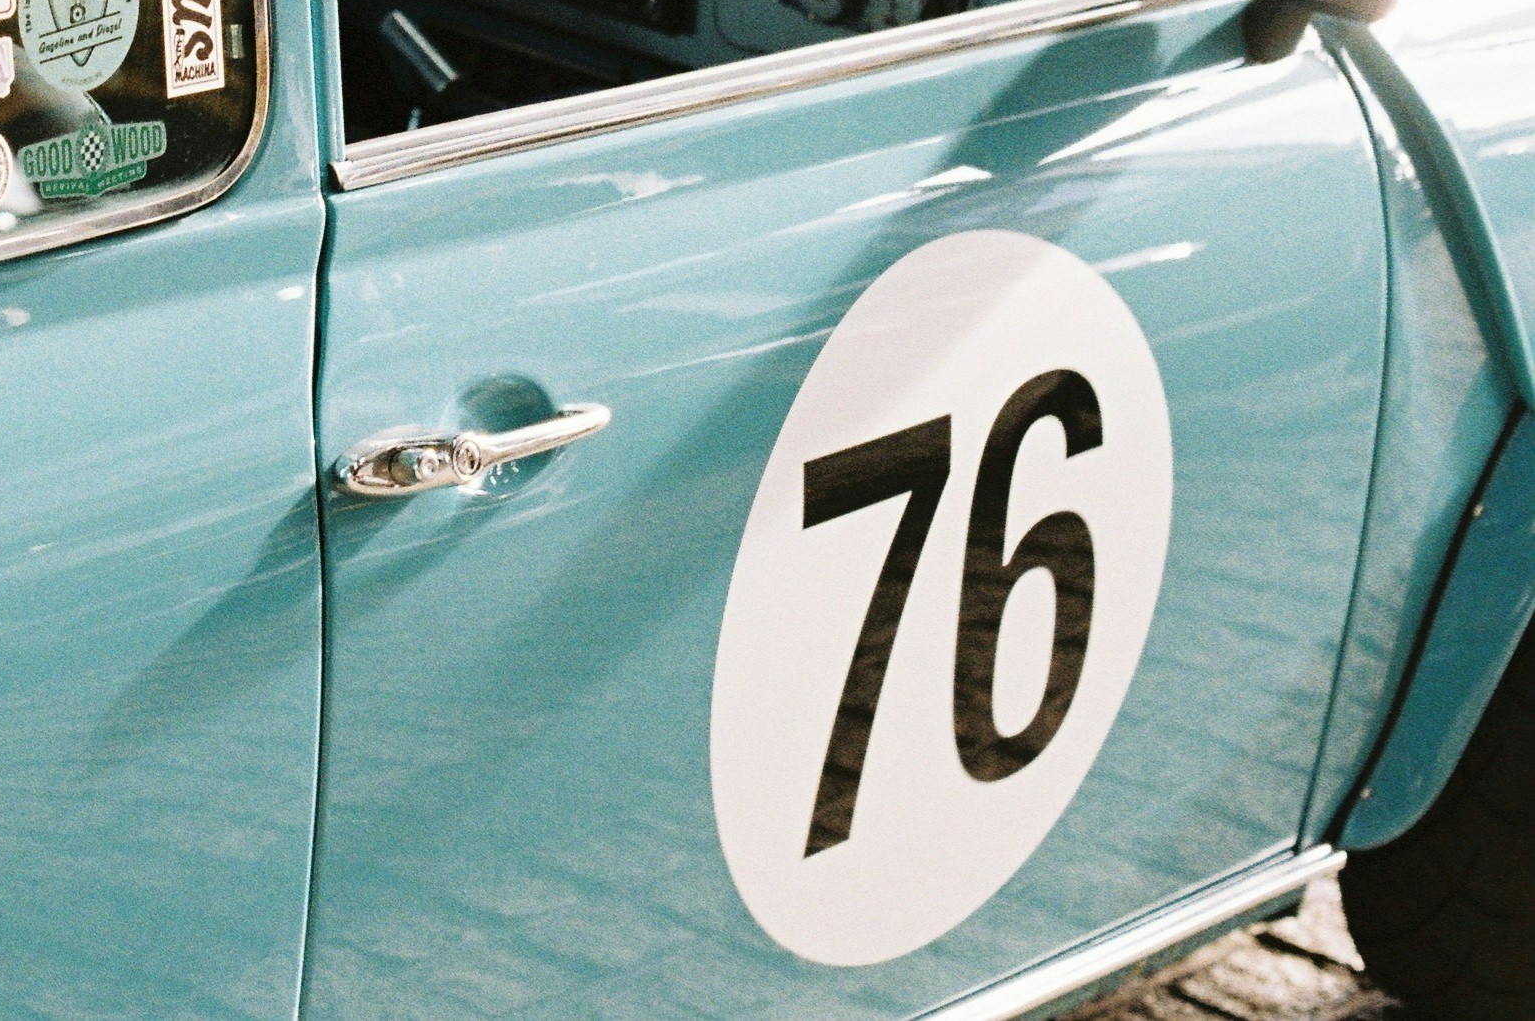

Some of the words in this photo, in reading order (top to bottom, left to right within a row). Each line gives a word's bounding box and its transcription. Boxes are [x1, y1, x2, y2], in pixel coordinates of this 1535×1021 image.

[22, 138, 73, 178] GOOD
[110, 124, 163, 165] WOOD
[802, 367, 1103, 859] 76
